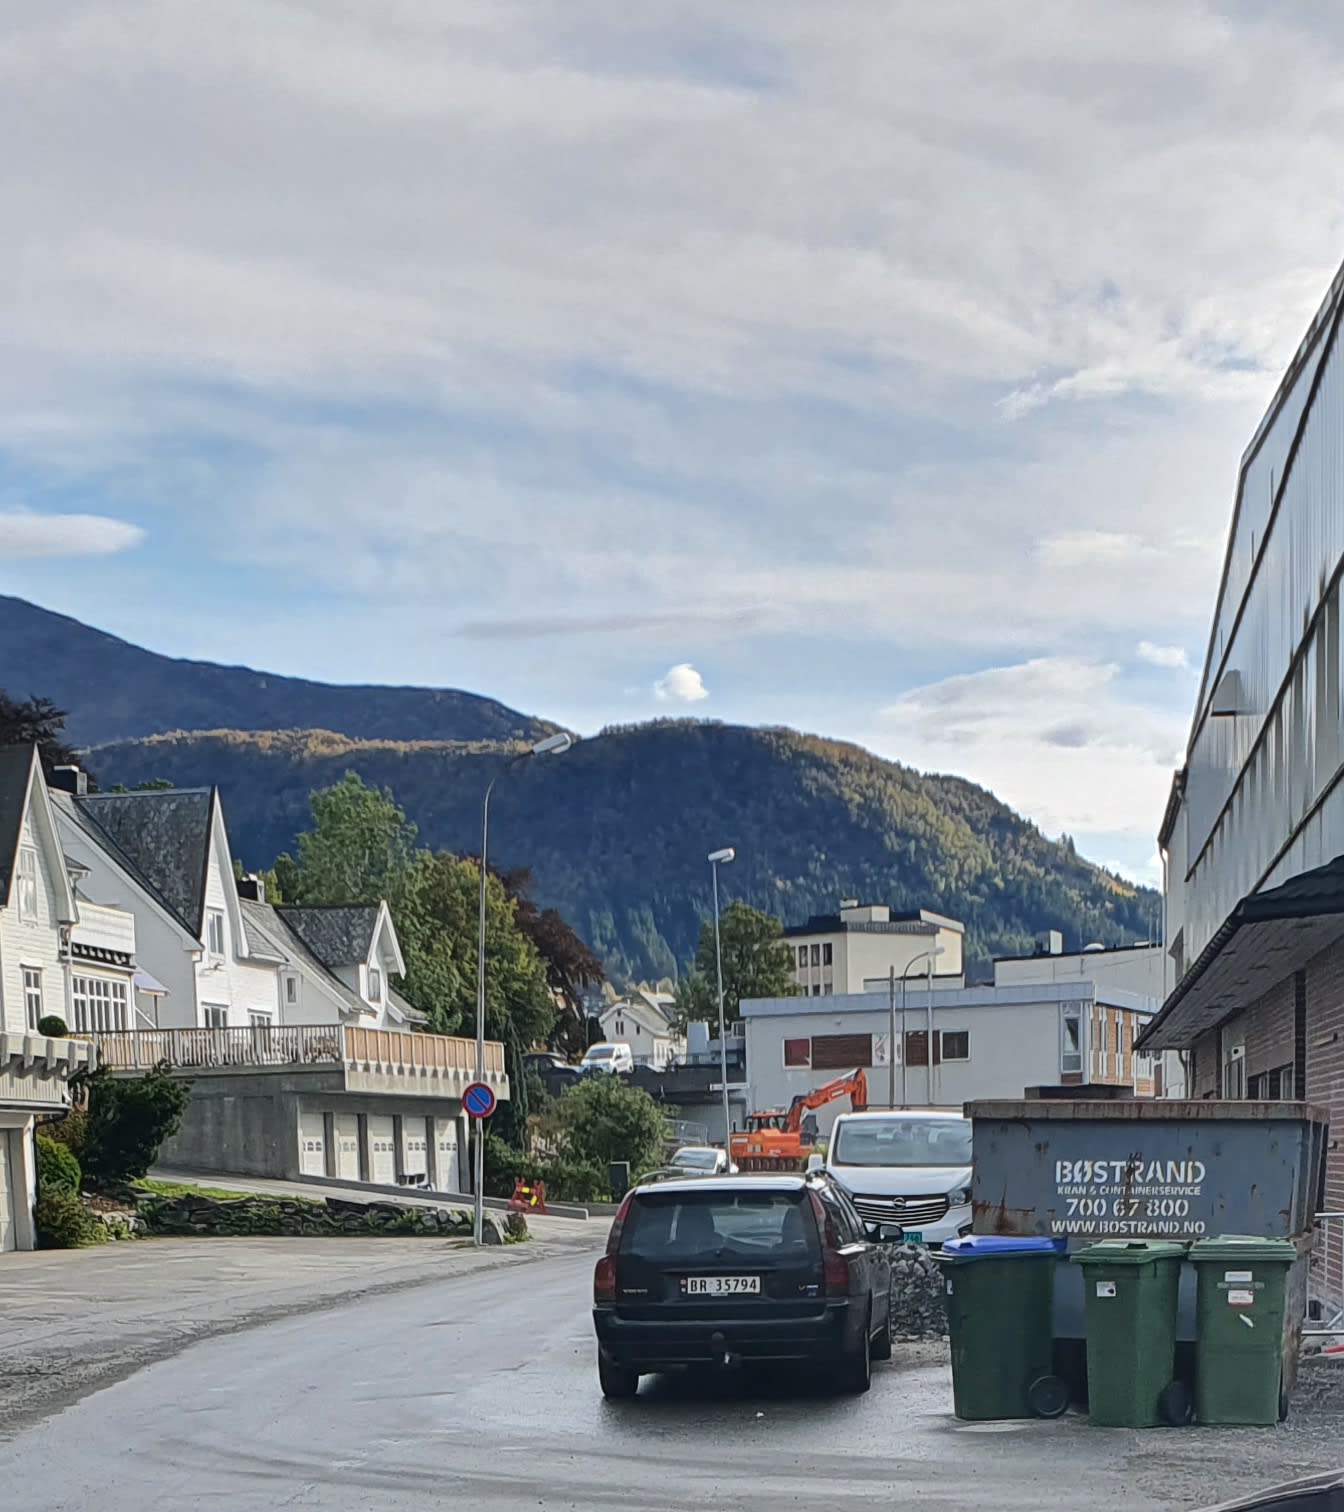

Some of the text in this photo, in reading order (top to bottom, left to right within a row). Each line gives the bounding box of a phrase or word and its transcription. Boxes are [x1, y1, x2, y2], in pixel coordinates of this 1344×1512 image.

[1056, 1160, 1206, 1184] BØSTRAND
[1057, 1186, 1087, 1196] KRAN
[1065, 1199, 1189, 1217] 700 67 800
[690, 1278, 758, 1292] BR 35794
